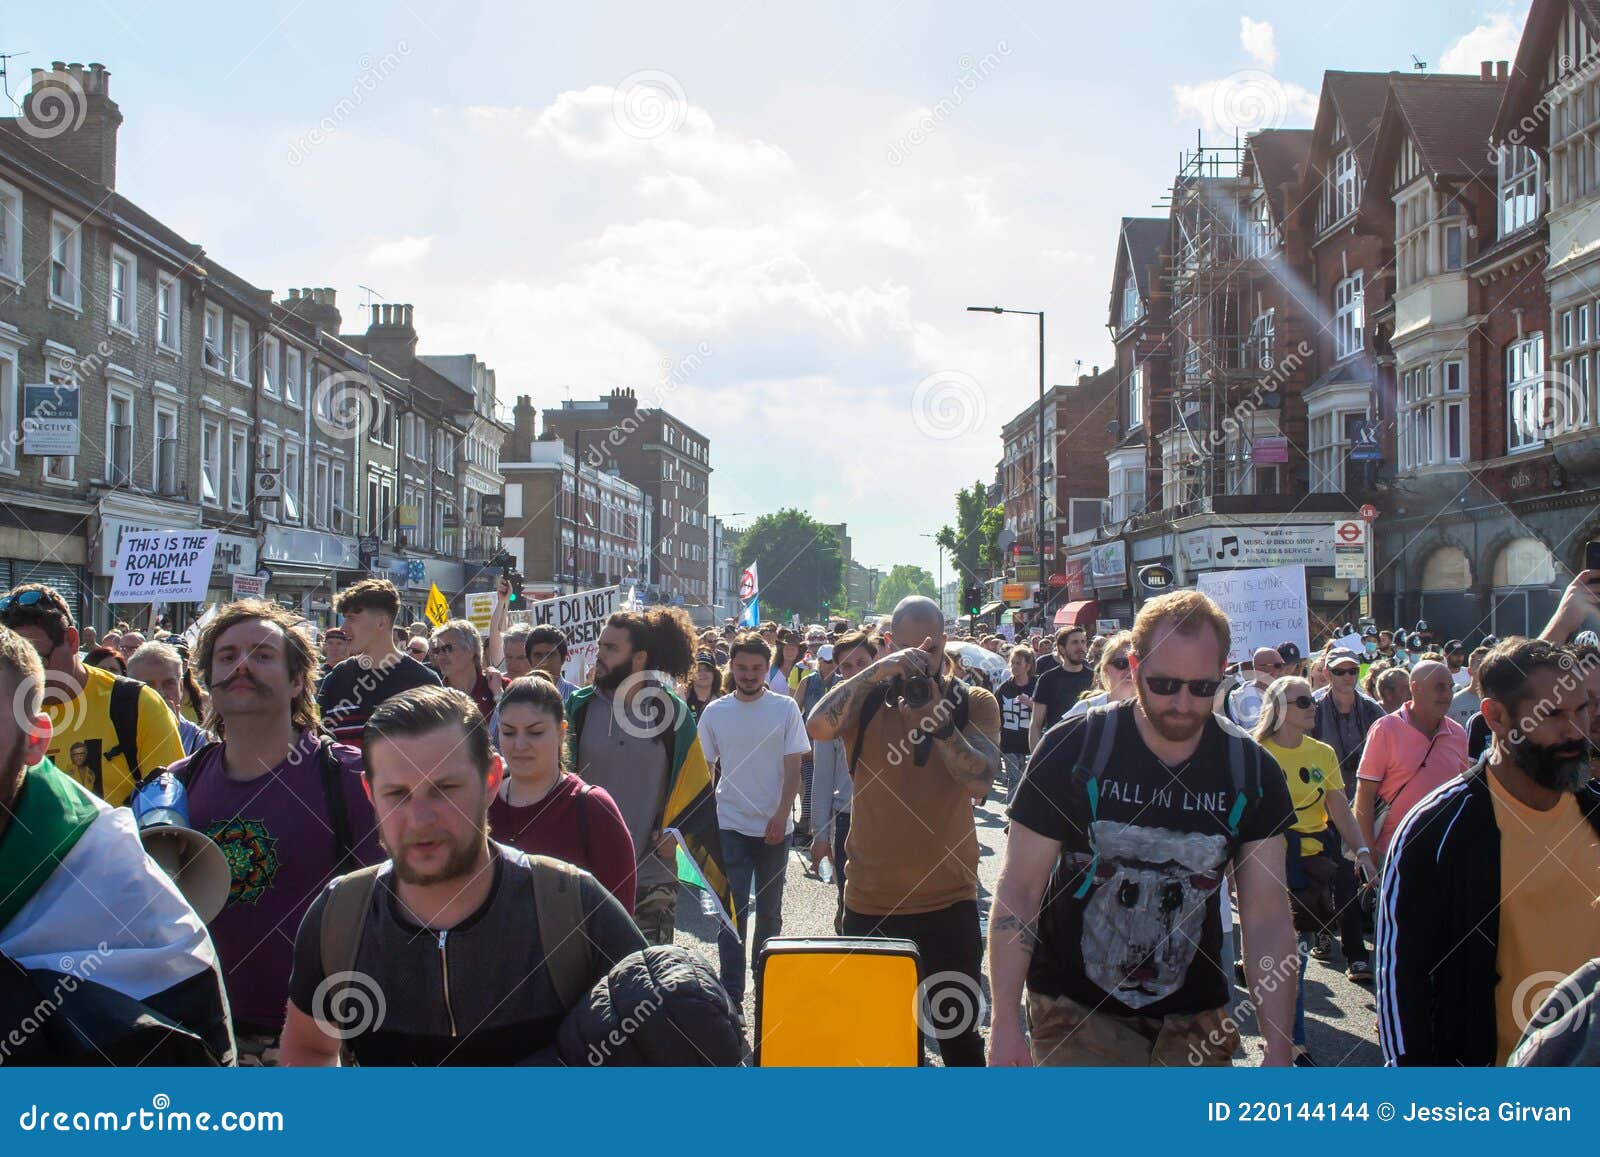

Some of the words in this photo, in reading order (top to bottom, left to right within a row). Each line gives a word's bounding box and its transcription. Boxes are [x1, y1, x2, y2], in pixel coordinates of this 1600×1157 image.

[128, 538, 160, 552] THIS
[164, 537, 178, 550] IS
[182, 536, 207, 549] THE
[126, 551, 198, 570] ROADMAP
[128, 572, 145, 587] TO
[151, 569, 191, 586] HELL
[535, 602, 555, 625] WE
[559, 598, 580, 626] DO
[584, 589, 615, 621] NOT
[1100, 779, 1144, 804] FALL
[1151, 787, 1172, 808] IN
[1183, 791, 1228, 812] LINE
